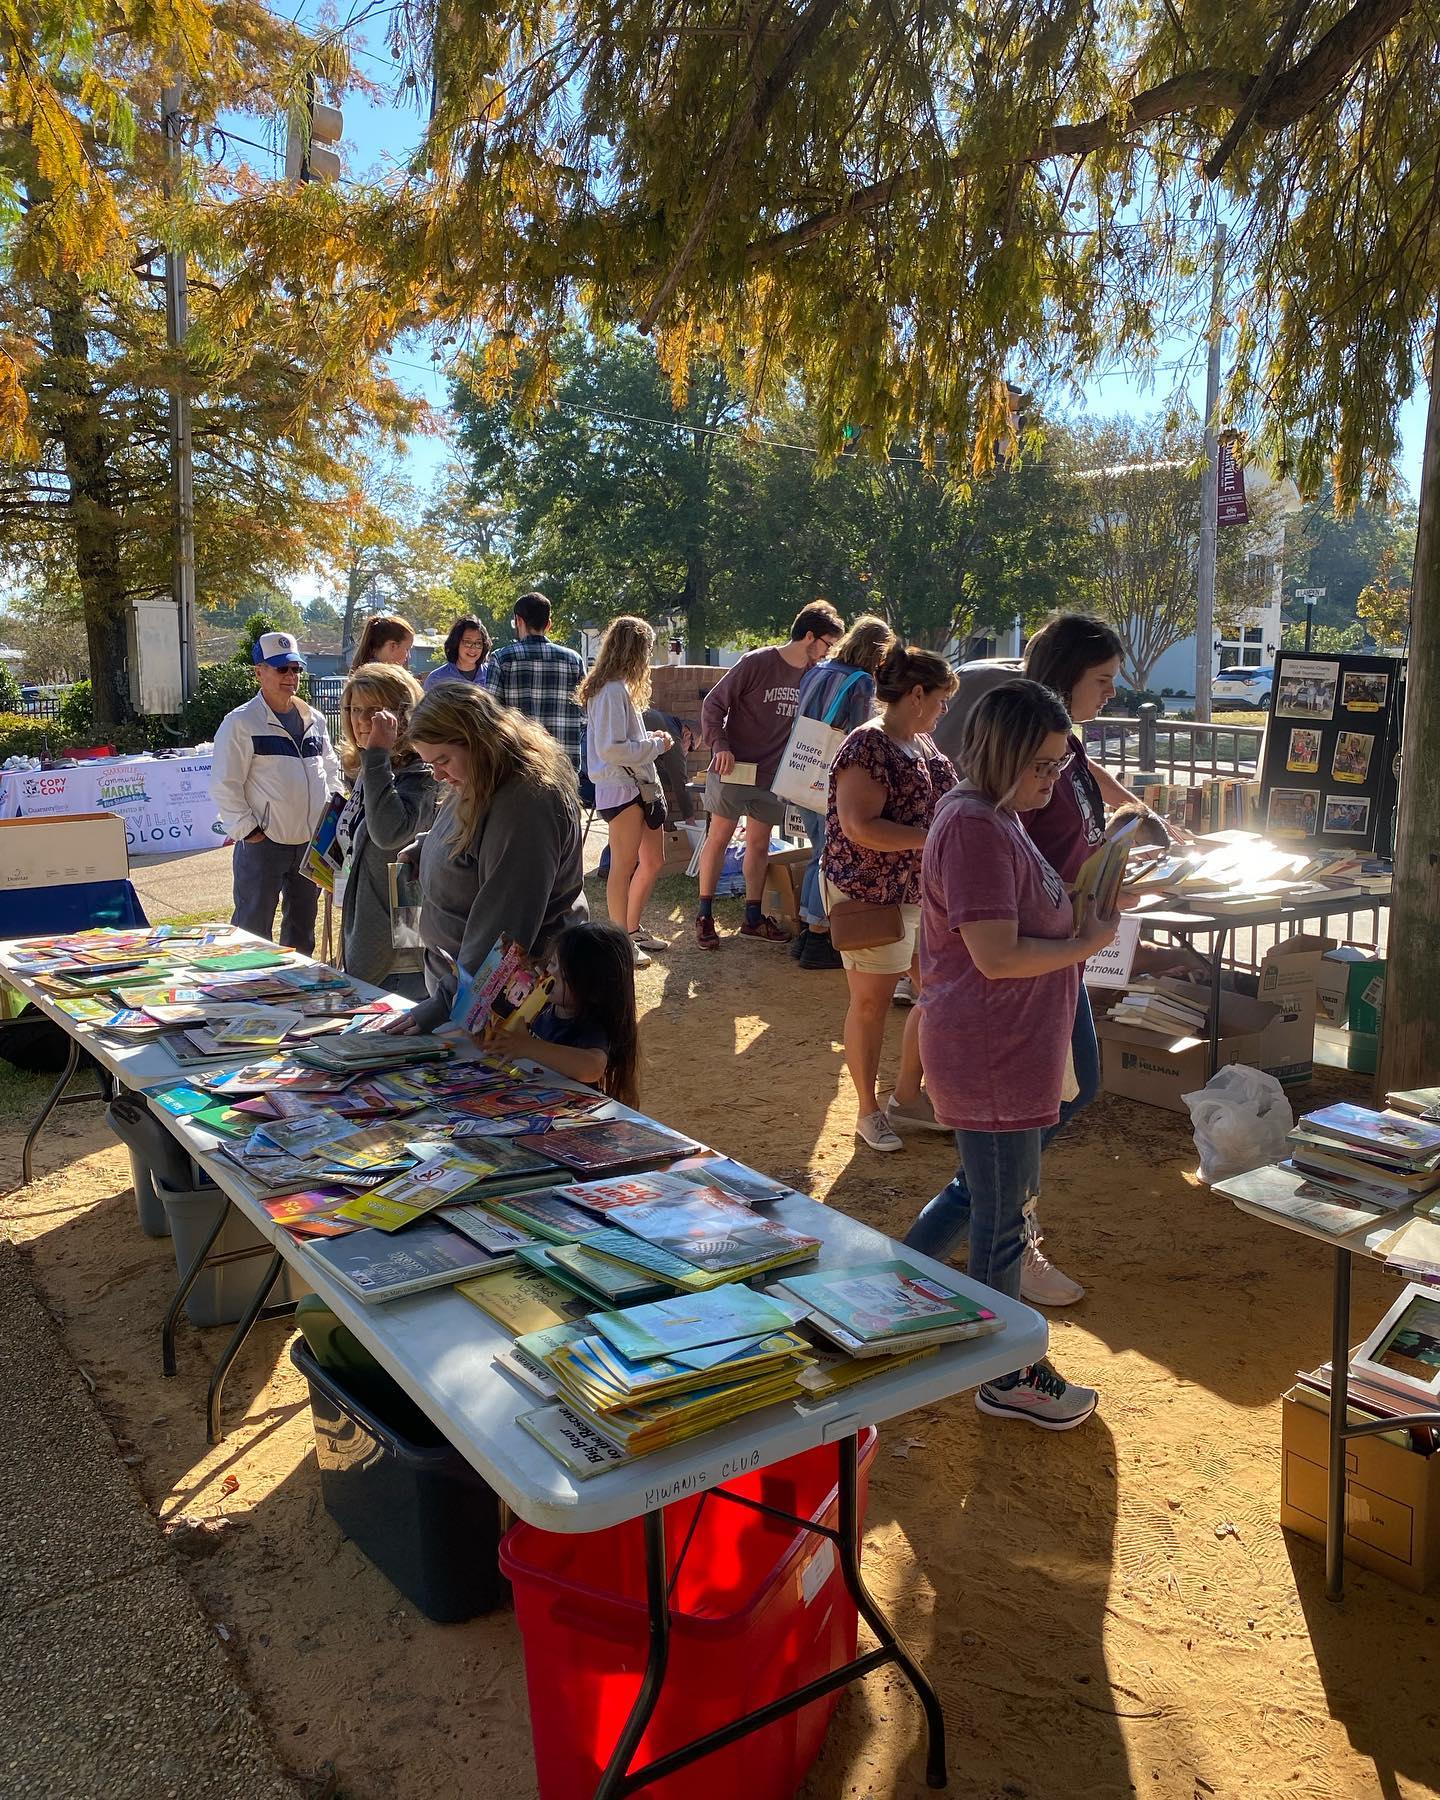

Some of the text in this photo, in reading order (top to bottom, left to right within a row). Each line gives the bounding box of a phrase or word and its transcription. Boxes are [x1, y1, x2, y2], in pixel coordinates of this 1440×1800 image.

[796, 741, 823, 757] Unsere
[789, 760, 806, 772] Welt
[40, 778, 66, 787] COPY
[41, 786, 65, 796] COW
[101, 783, 146, 799] MARKET
[564, 1187, 622, 1209] More
[617, 1183, 663, 1200] One
[558, 1407, 623, 1460] to the Rescue
[560, 1429, 605, 1464] Big Bear
[645, 1449, 760, 1509] KIWANIS CLUB
